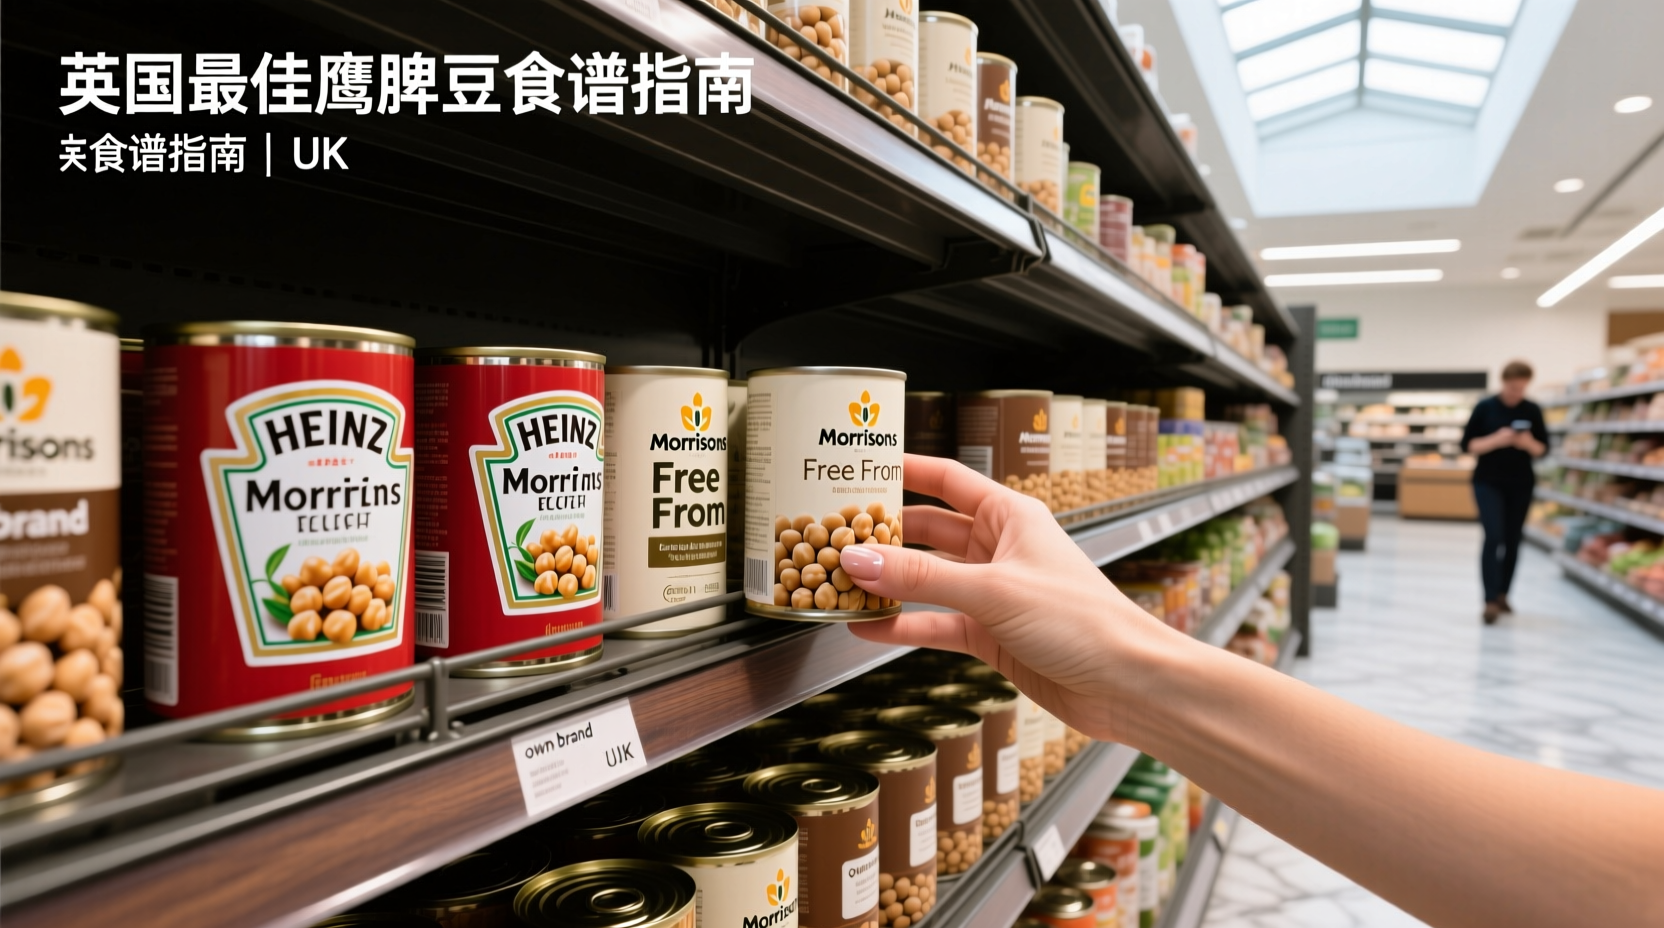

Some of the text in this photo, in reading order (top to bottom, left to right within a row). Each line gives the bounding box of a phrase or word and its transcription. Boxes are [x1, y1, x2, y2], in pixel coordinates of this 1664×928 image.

[265, 409, 388, 456] HEINZ
[516, 413, 597, 452] HEINZ
[649, 433, 727, 452] Morrisons
[818, 428, 898, 447] Morrisons
[652, 461, 720, 494] Free
[803, 458, 902, 482] Free From
[652, 497, 725, 529] From
[525, 721, 593, 759] own brand
